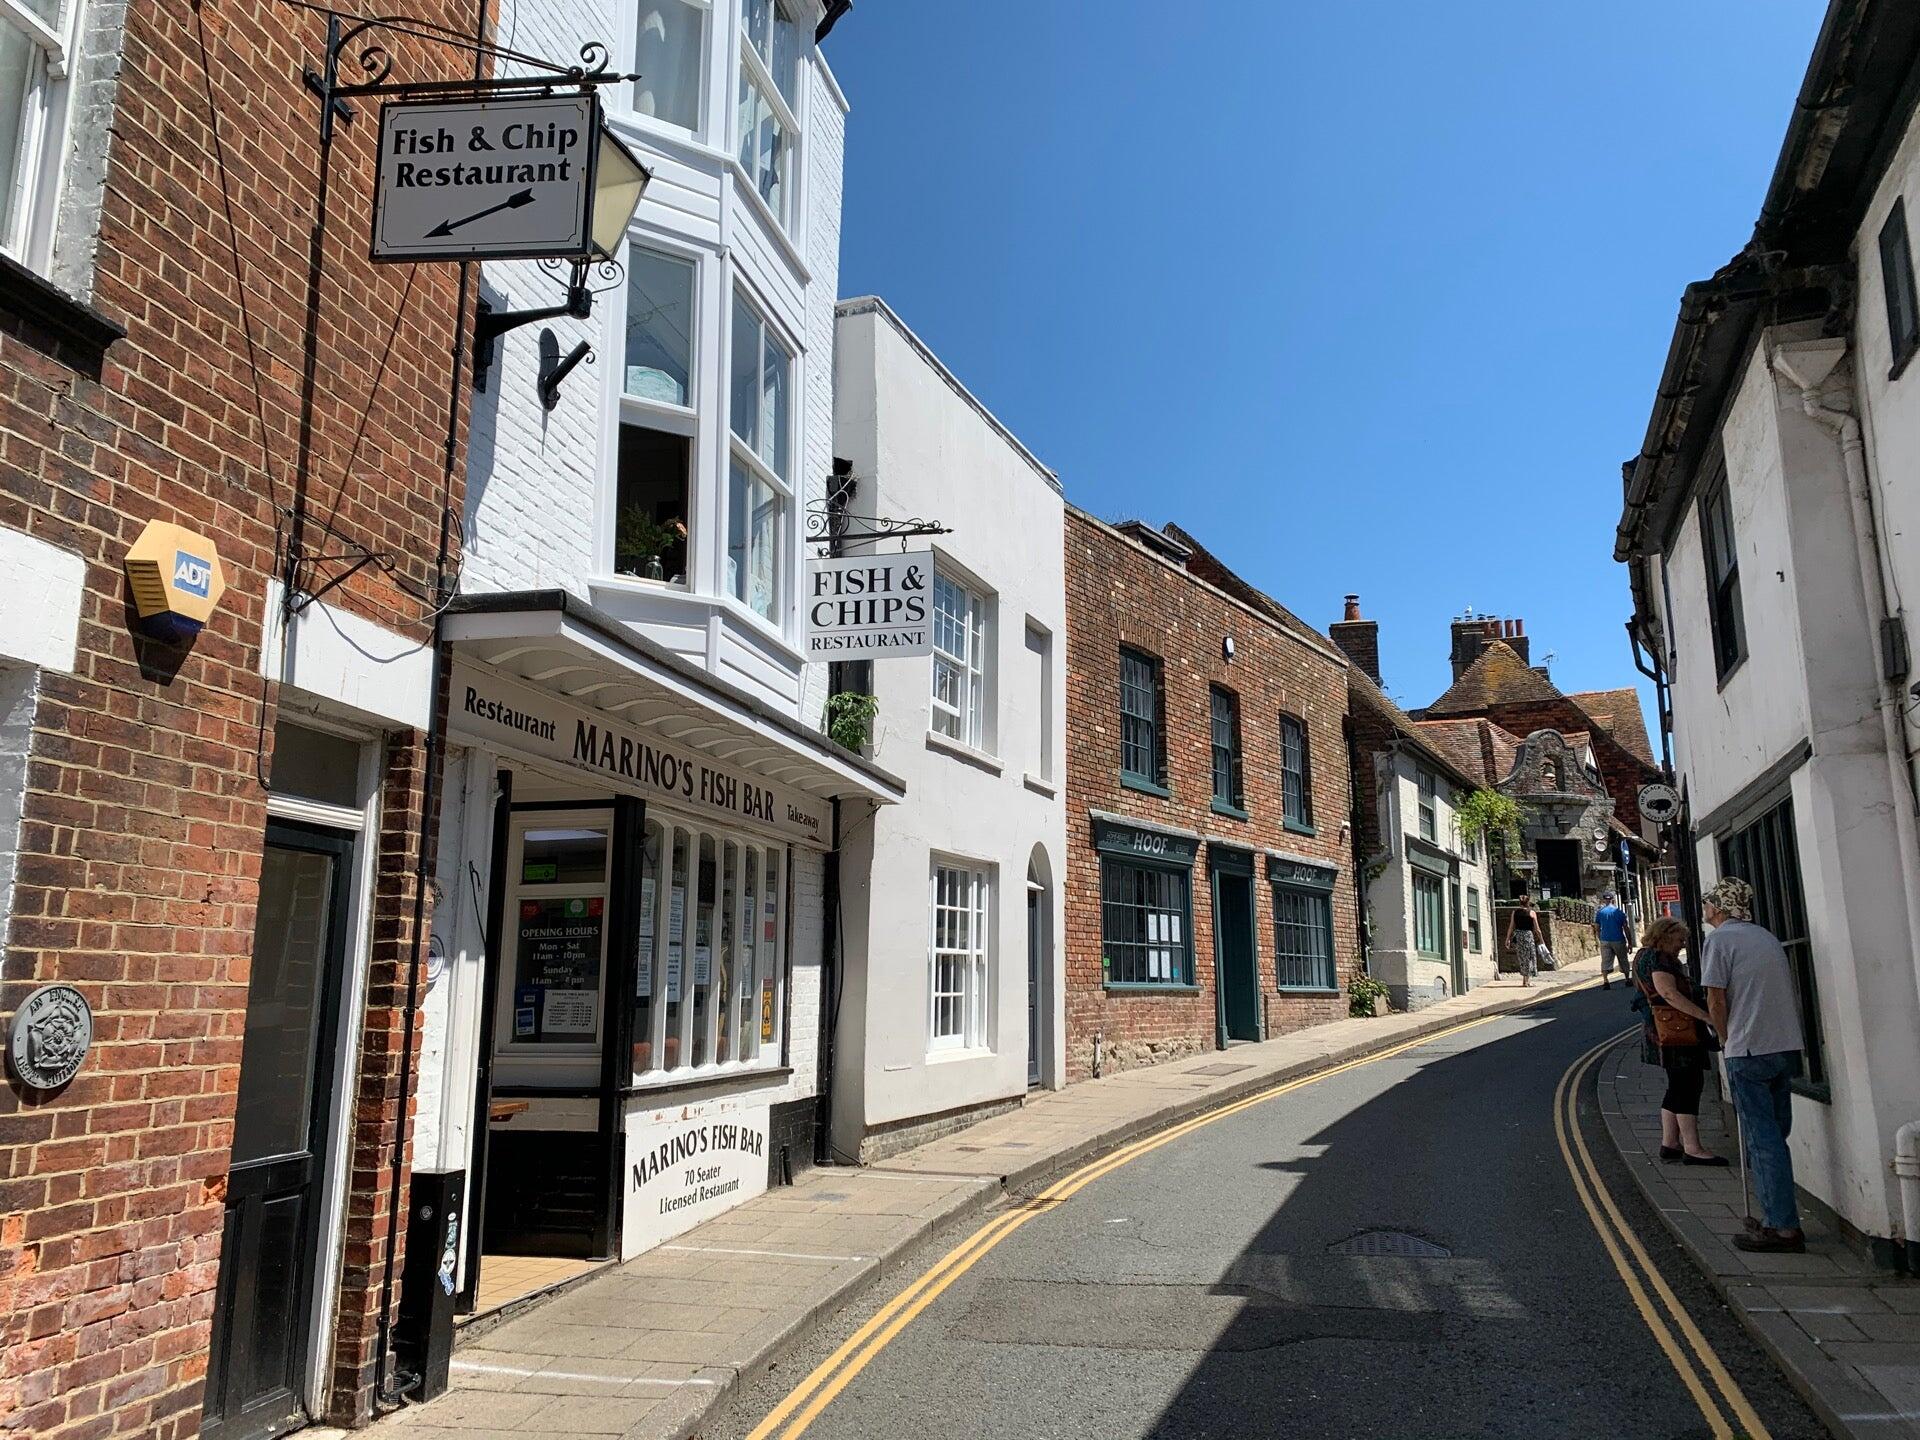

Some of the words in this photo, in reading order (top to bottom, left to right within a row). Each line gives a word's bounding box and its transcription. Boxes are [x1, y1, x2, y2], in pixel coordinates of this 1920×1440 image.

[393, 127, 455, 155] Fish
[468, 126, 496, 151] &
[502, 123, 578, 155] Chip
[396, 158, 571, 188] Restaurant
[175, 561, 211, 589] ADT
[812, 567, 894, 596] FISH
[901, 565, 925, 591] &
[811, 596, 925, 627] CHIPS
[811, 632, 925, 650] RESTAURANT
[465, 686, 556, 742] Restaurant
[573, 718, 694, 798] MARINO'S
[700, 767, 737, 811] FISH
[742, 783, 776, 823] BAR
[786, 804, 820, 833] Takeaway
[1133, 832, 1168, 855] HOOF
[1294, 865, 1317, 882] HOOF
[521, 928, 563, 938] OPENING
[566, 926, 599, 936] HOURS
[539, 943, 558, 951] Mon
[567, 942, 580, 950] Sat
[543, 966, 574, 975] Sunday
[632, 1126, 708, 1194] MARINO'S
[712, 1124, 738, 1150] FISH
[740, 1126, 763, 1157] BAR
[684, 1170, 695, 1187] 70
[697, 1166, 721, 1183] Seater
[660, 1189, 697, 1214] Licensed
[699, 1178, 739, 1202] Restaurant
